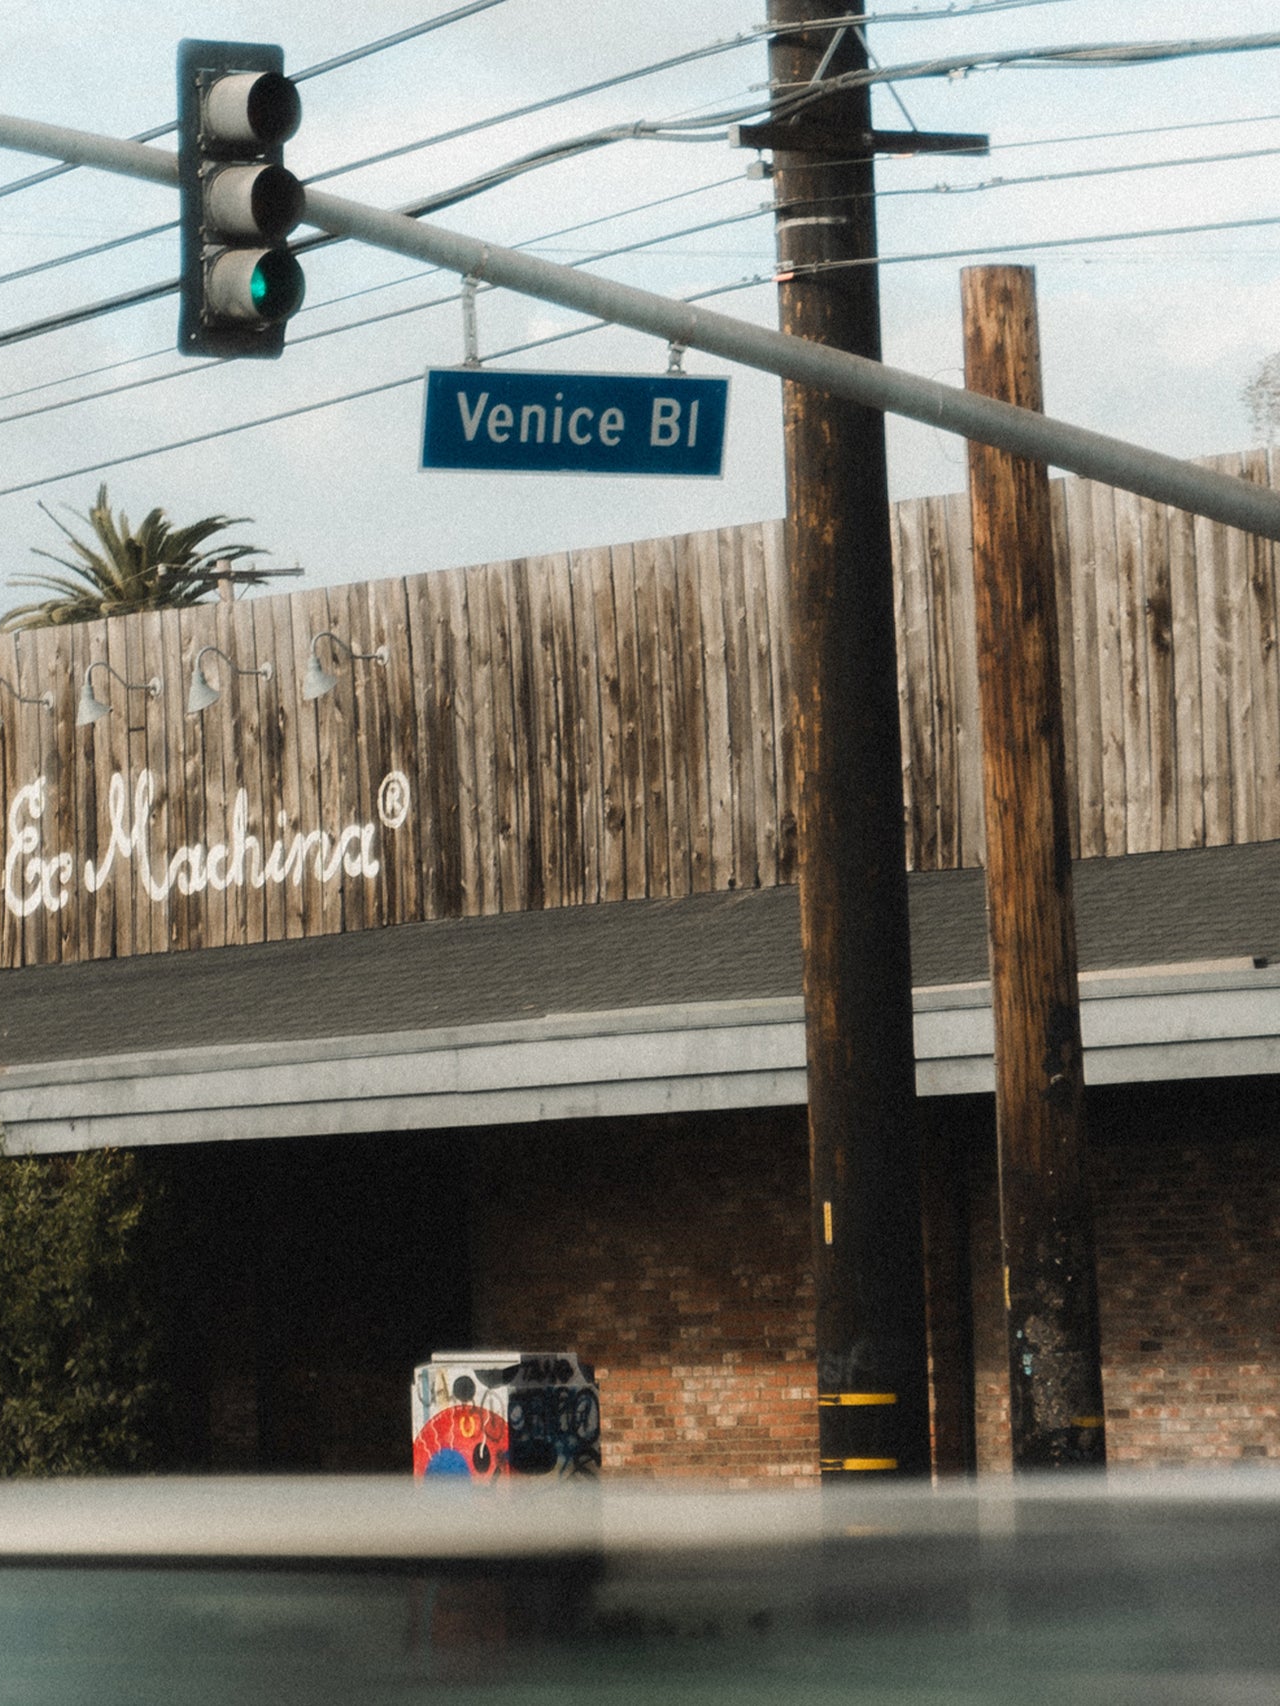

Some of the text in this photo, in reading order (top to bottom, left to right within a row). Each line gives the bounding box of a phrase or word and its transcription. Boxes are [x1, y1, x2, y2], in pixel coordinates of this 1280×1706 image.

[457, 391, 699, 447] Venice Bl
[4, 775, 73, 917] Ex
